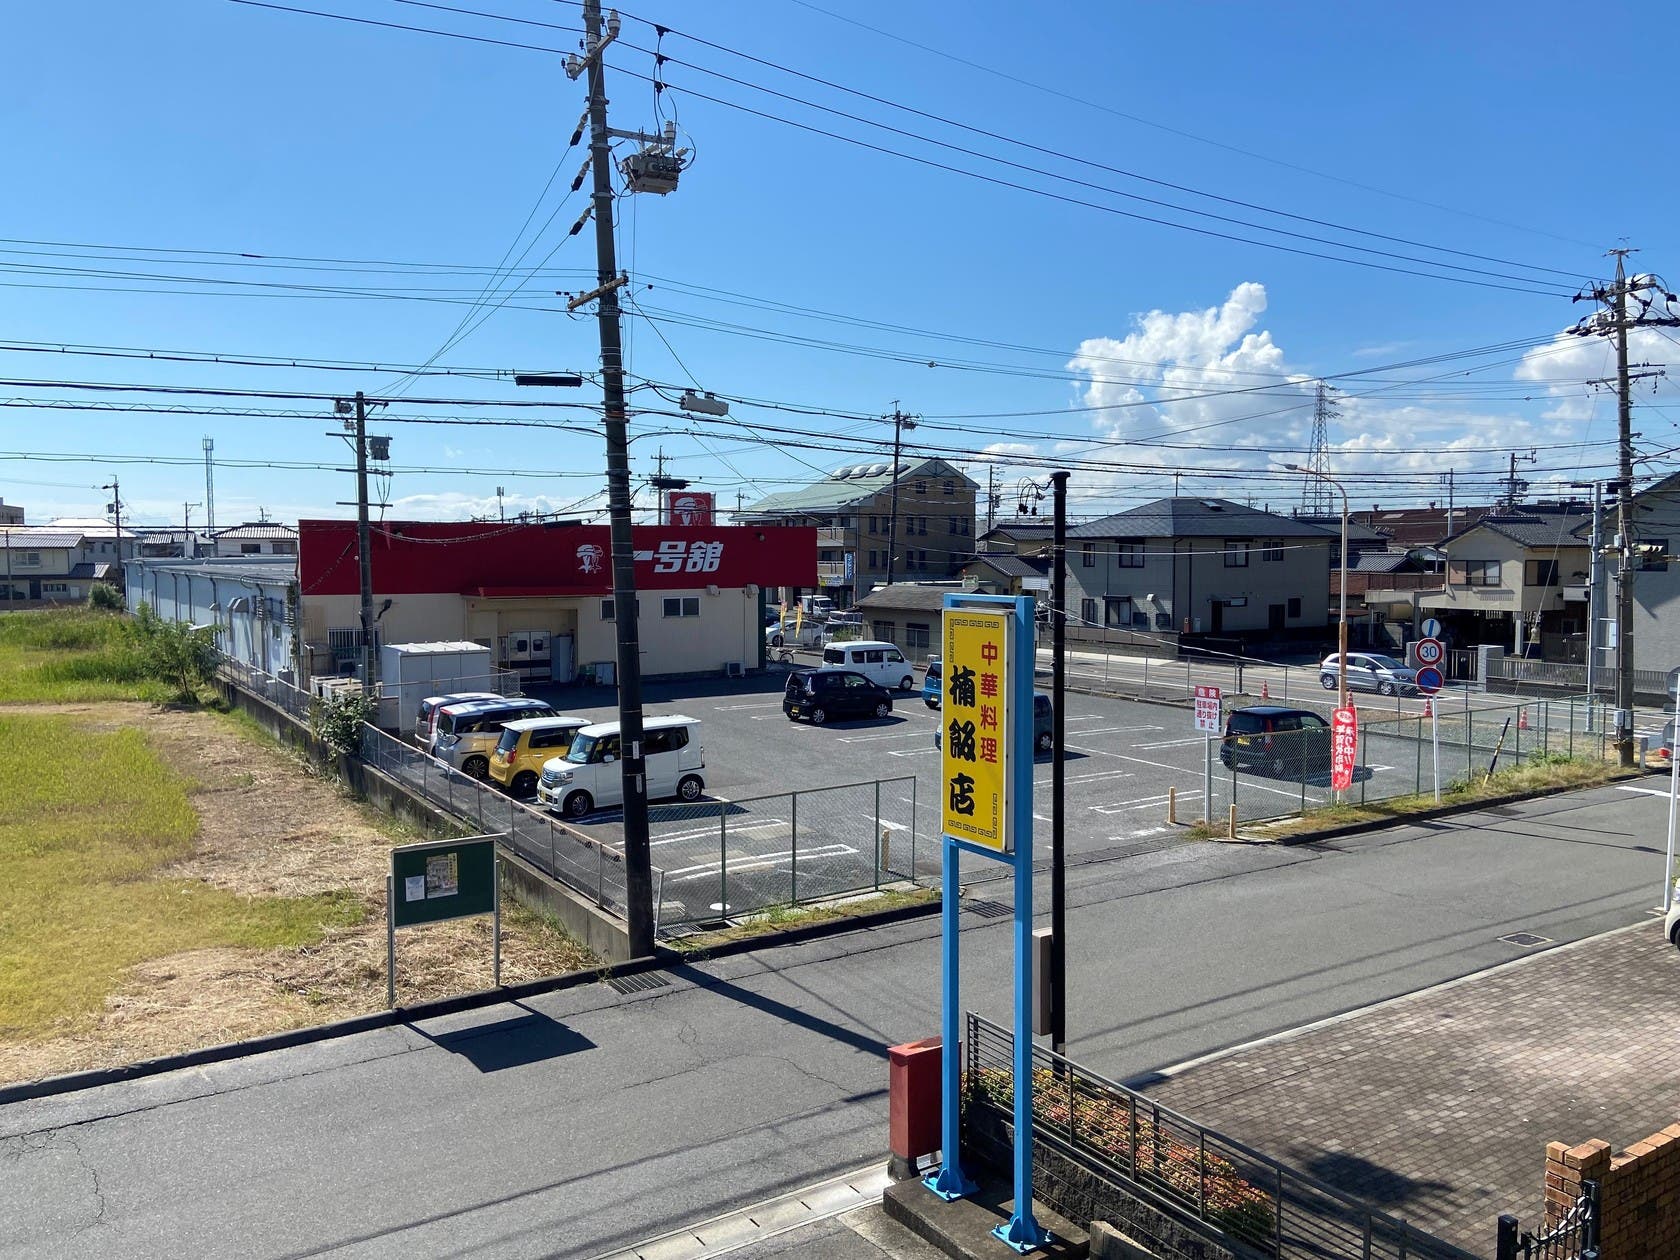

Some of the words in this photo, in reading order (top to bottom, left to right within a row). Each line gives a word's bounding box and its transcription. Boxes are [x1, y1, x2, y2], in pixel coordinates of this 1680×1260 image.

[979, 641, 998, 763] 中華料理
[1422, 646, 1437, 658] 30
[948, 664, 977, 817] 楠飯店
